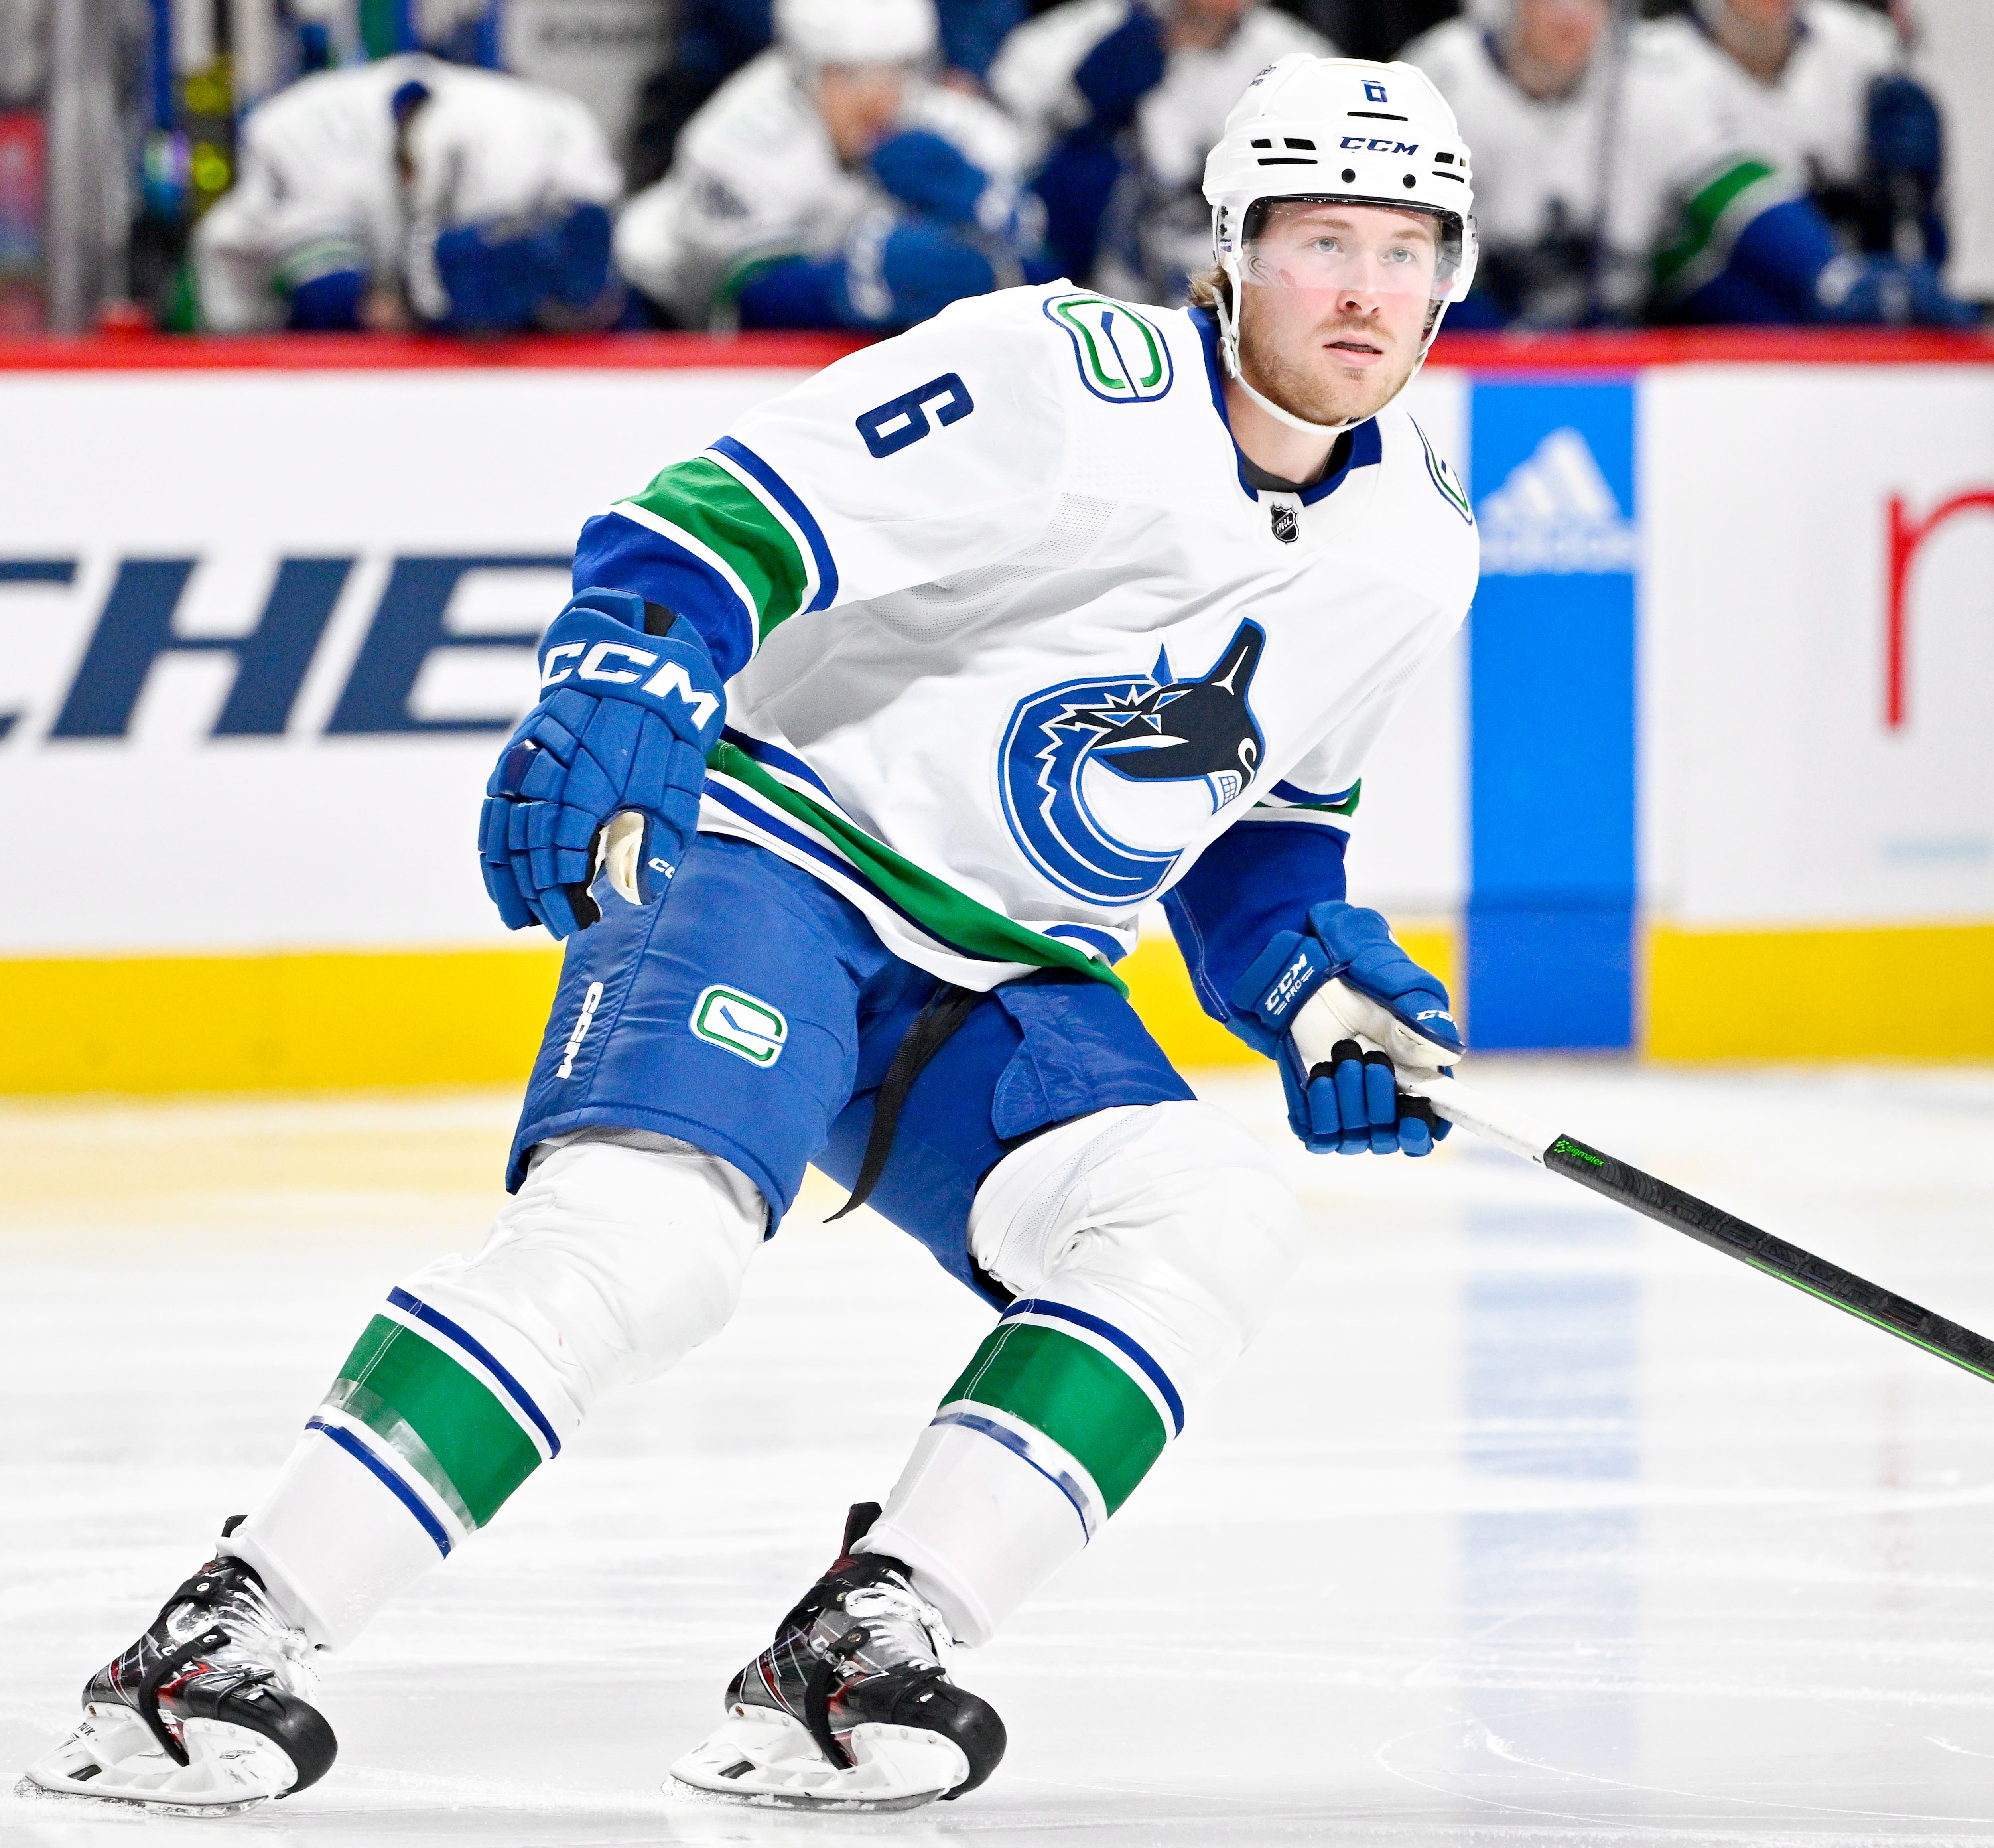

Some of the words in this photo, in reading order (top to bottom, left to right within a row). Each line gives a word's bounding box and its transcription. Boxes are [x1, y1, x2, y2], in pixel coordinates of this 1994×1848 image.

[1340, 136, 1419, 156] CCM
[856, 373, 974, 458] 6
[1276, 516, 1293, 535] NHL
[541, 641, 720, 731] CCM
[1265, 953, 1307, 1011] CCM
[1285, 980, 1302, 1002] PRO
[556, 981, 604, 1079] CCM
[1566, 1146, 1605, 1166] sigmatex
